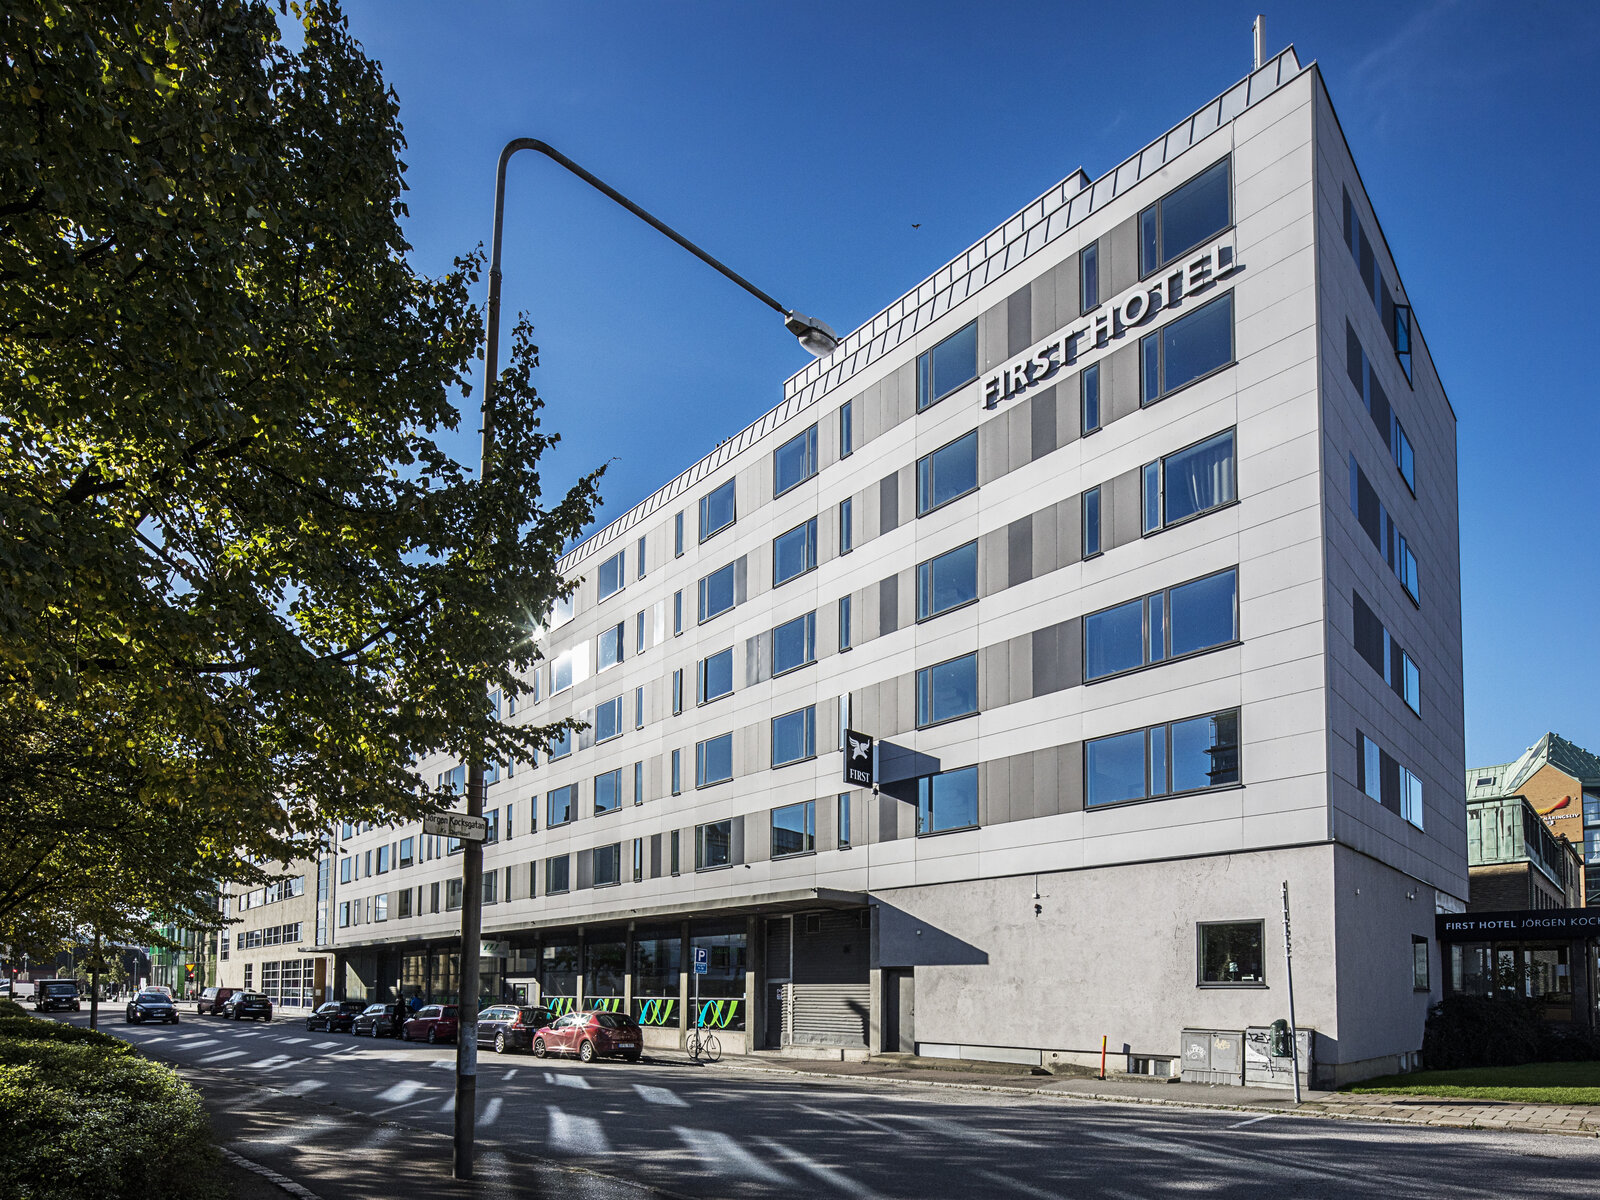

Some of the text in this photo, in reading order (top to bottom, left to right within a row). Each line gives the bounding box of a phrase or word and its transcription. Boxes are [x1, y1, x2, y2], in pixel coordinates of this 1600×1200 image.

[981, 244, 1234, 409] FIRST HOTEL
[850, 768, 870, 783] FIRST
[449, 816, 485, 830] Kocksgatan
[1446, 921, 1475, 930] FIRST
[1479, 920, 1517, 929] HOTEL
[1521, 918, 1566, 928] JÖRGEN
[698, 950, 705, 962] P
